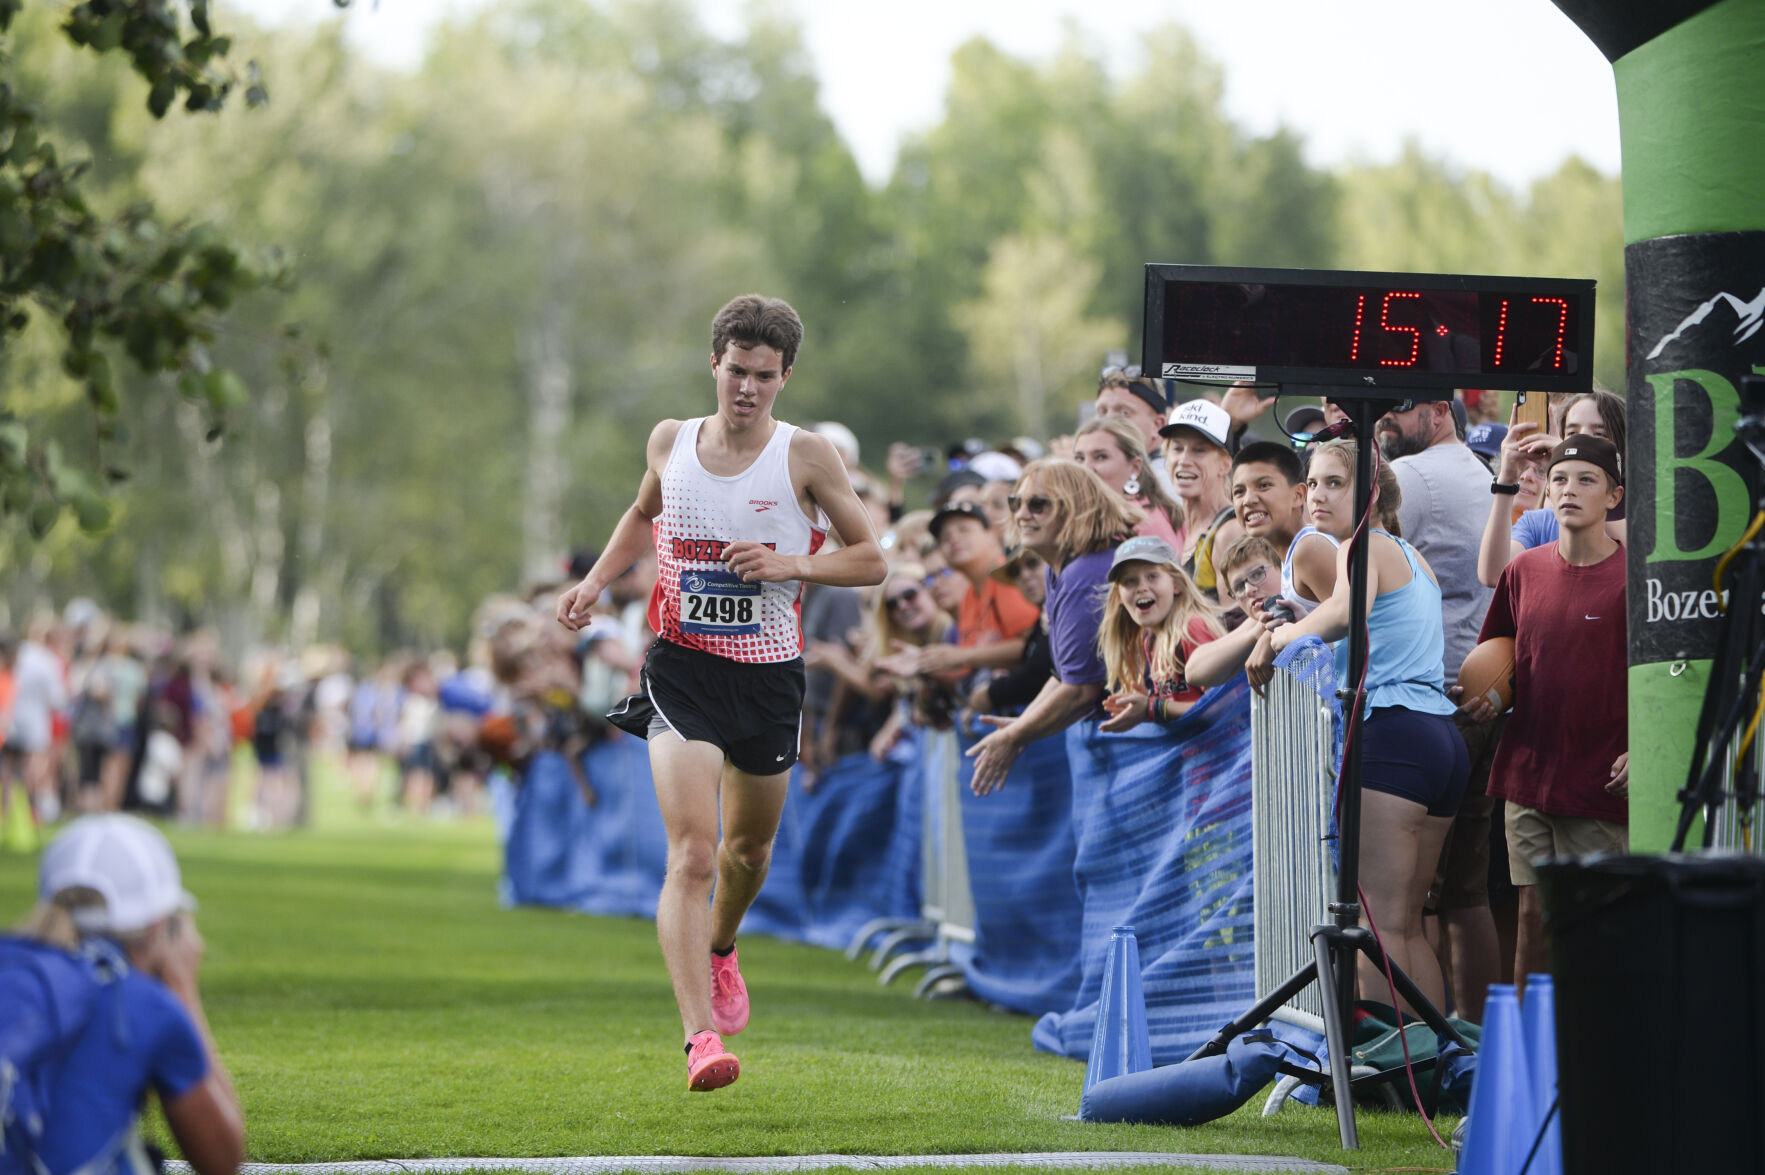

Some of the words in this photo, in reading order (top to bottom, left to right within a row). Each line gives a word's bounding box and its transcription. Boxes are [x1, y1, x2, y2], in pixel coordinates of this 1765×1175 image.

[1164, 364, 1221, 374] Raceclock
[749, 499, 779, 507] BROOKS
[671, 537, 777, 563] BOZE
[707, 581, 738, 589] Competitive
[688, 595, 753, 624] 2498
